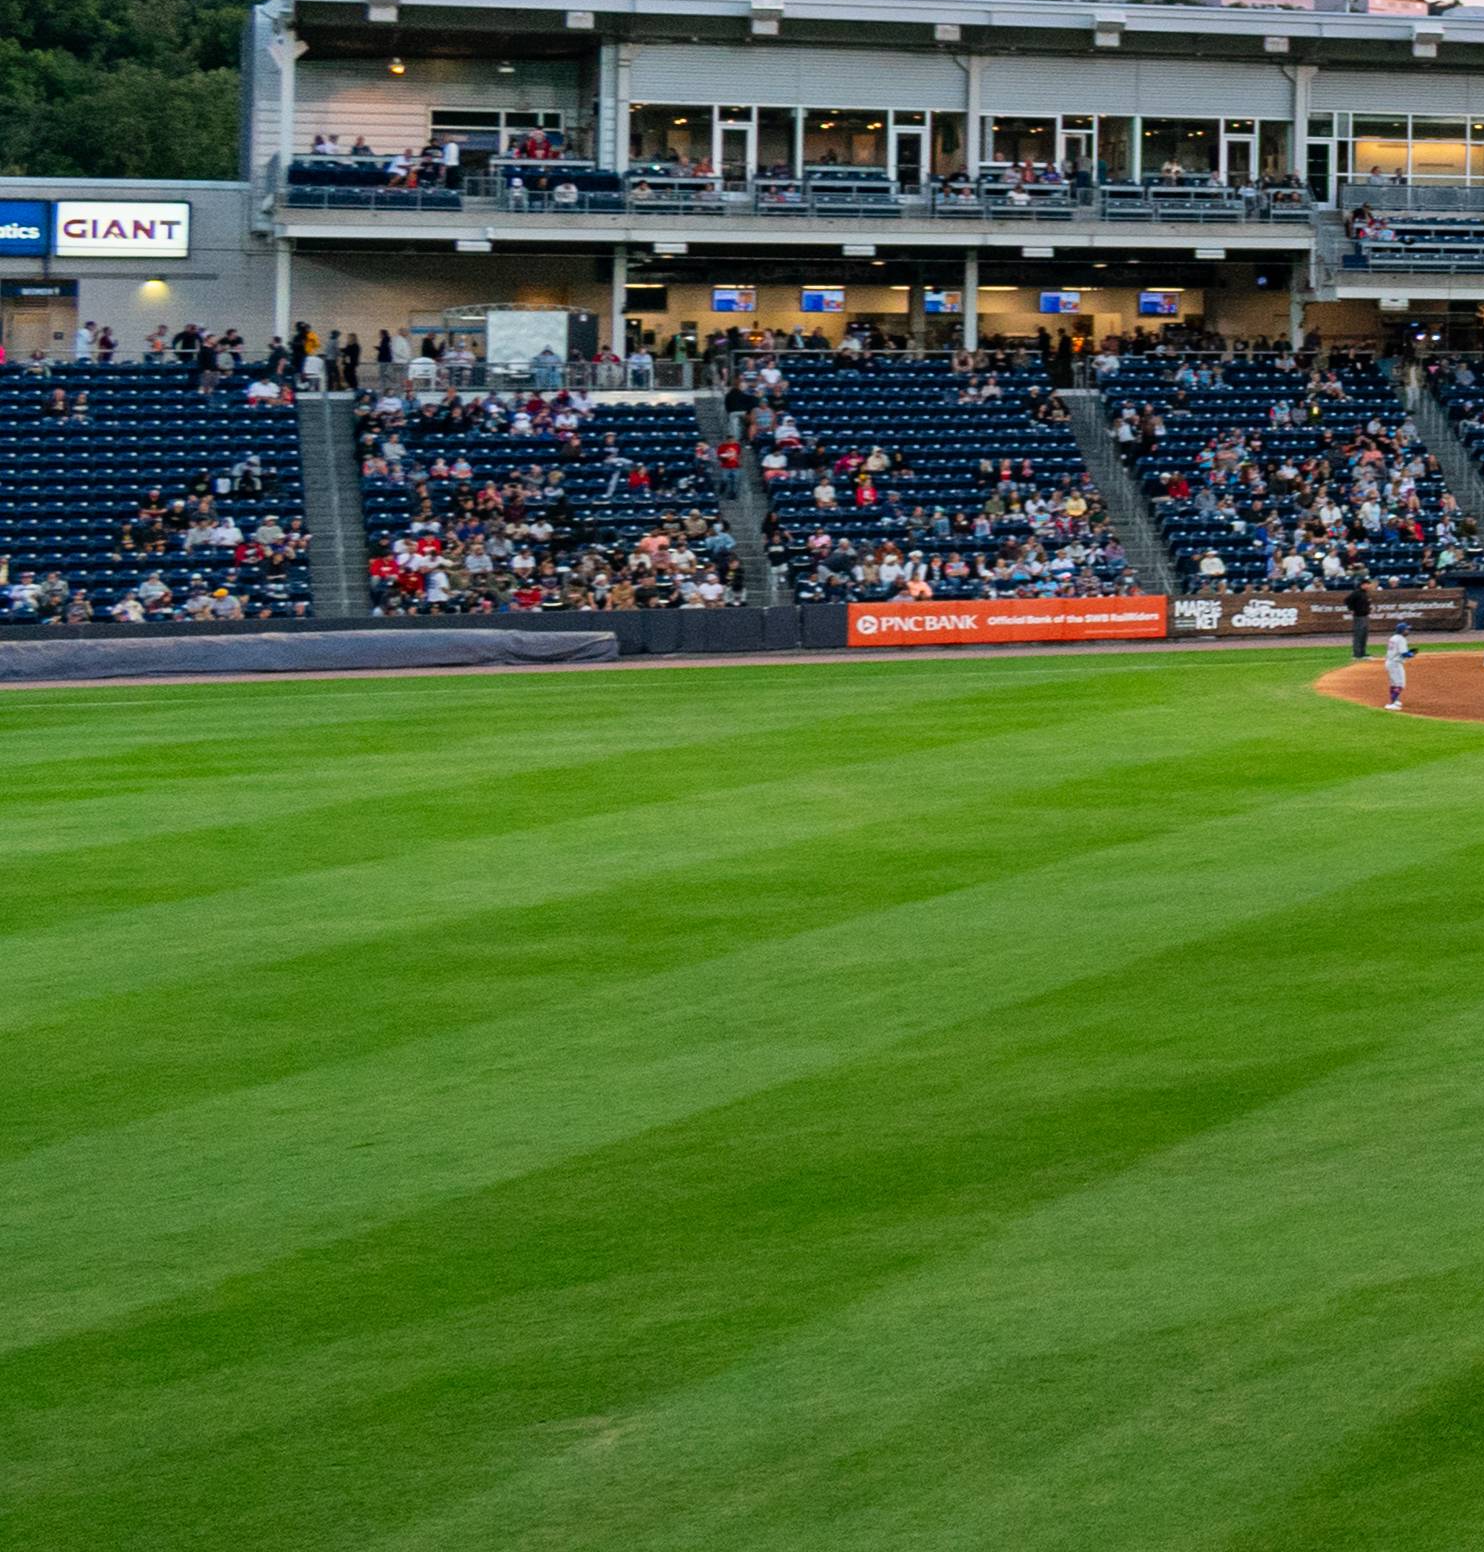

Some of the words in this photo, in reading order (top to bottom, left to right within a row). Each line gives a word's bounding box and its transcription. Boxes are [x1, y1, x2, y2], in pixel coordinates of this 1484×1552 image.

[64, 219, 181, 239] GIANT
[880, 616, 923, 631] PNC
[924, 614, 979, 630] BANK
